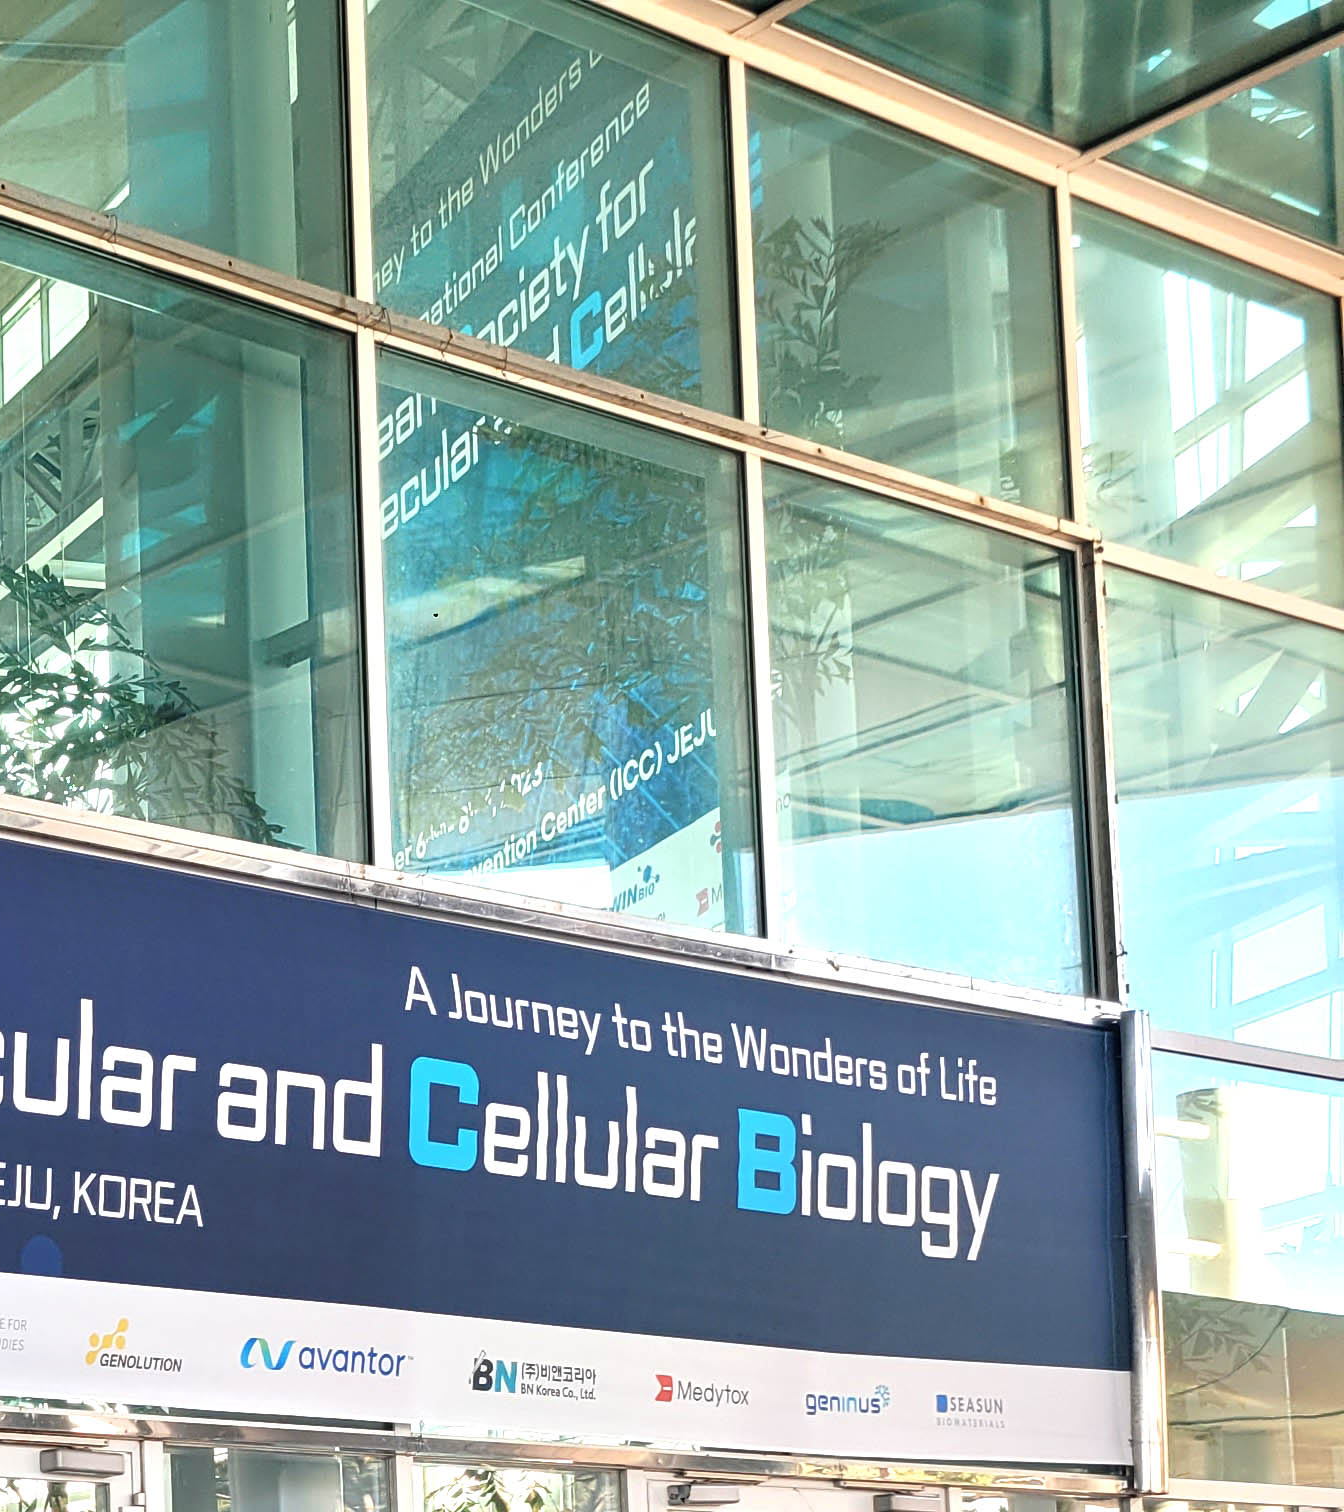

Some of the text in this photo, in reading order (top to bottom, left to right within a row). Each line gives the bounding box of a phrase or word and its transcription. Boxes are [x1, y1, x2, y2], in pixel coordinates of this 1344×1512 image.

[411, 219, 432, 256] to
[438, 177, 473, 229] the
[479, 58, 581, 184] Wonders
[509, 81, 650, 250] Conference
[460, 224, 590, 348] ociety
[596, 159, 654, 254] for
[541, 785, 606, 842] Center
[610, 741, 662, 801] (ICC)
[404, 965, 998, 1106] A Journey to the Wonders of Life
[216, 1044, 384, 1158] and
[409, 1056, 719, 1202] Cellular
[737, 1107, 1000, 1261] Biology
[73, 1173, 205, 1229] KOREA
[8, 1318, 28, 1332] FOR
[99, 1353, 183, 1374] GENOLUTION
[520, 1382, 534, 1396] BN
[535, 1383, 561, 1398] Korea
[677, 1380, 750, 1408] Medytox
[805, 1393, 881, 1416] geninus
[949, 1396, 1004, 1415] SEASUN
